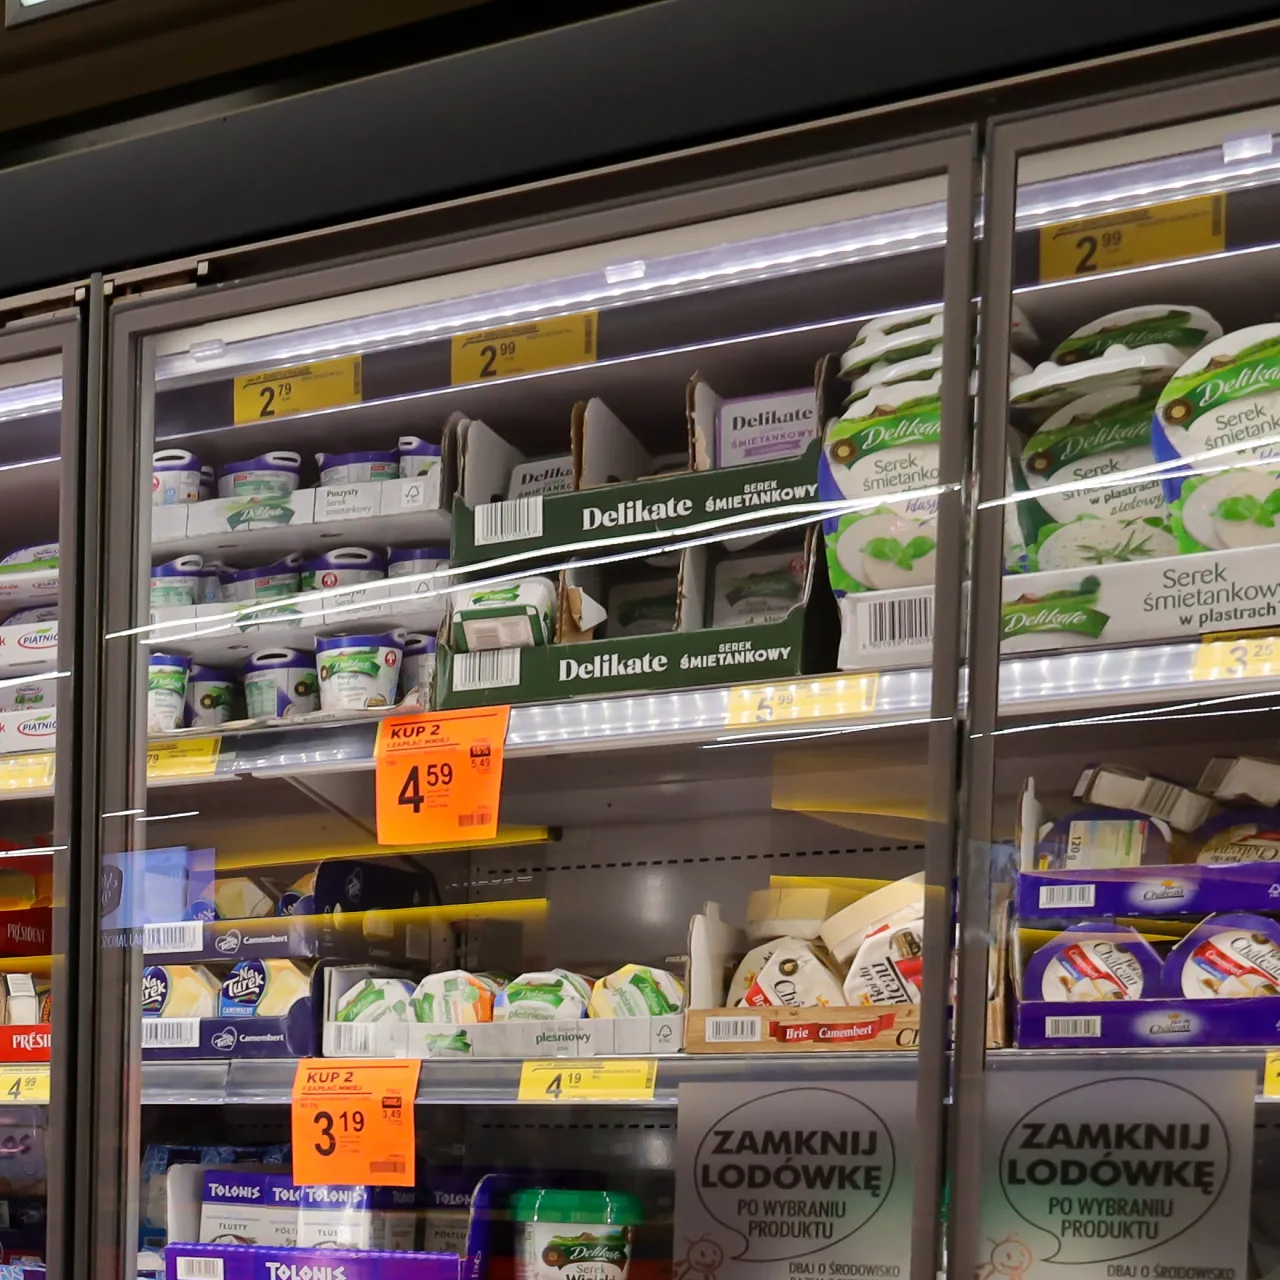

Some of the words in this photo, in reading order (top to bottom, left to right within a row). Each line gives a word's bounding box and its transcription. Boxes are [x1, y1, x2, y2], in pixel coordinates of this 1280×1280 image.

[1076, 236, 1097, 273] 2
[1102, 230, 1122, 246] 99
[480, 346, 497, 377] 2
[500, 342, 515, 355] 99
[260, 387, 275, 416] 2
[278, 384, 291, 396] 79
[875, 454, 917, 475] Serek
[1073, 460, 1120, 482] Serek
[705, 483, 818, 512] ŚMIETANKOWY
[744, 481, 777, 492] SEREK
[582, 498, 692, 531] Delikate
[1162, 563, 1227, 588] Serek
[1179, 613, 1192, 626] w
[1199, 604, 1276, 627] plastrach
[680, 646, 791, 668] ŚMIETANKOWY
[719, 642, 751, 652] SEREK
[559, 652, 667, 681] Delikate
[391, 726, 426, 739] KUP
[430, 724, 440, 736] 2
[398, 766, 424, 813] 4
[427, 763, 452, 786] 59
[243, 934, 288, 945] Camembert
[223, 970, 264, 995] Turek
[240, 1033, 284, 1042] Camembert
[785, 1025, 808, 1039] Brie
[818, 1023, 872, 1039] Camembert
[307, 1072, 338, 1083] KUP
[342, 1072, 353, 1082] 2
[546, 1073, 562, 1099] 4
[568, 1073, 581, 1084] 19
[313, 1111, 335, 1156] 3
[339, 1112, 364, 1133] 19
[711, 1129, 877, 1155] ZAMKNIJ
[1018, 1122, 1210, 1150] ZAMKNIJ
[701, 1157, 882, 1197] LODÓWKĘ
[1007, 1153, 1214, 1195] LODÓWKĘ
[738, 1200, 759, 1215] PO
[762, 1200, 846, 1218] WYBRANIU
[1049, 1198, 1072, 1215] PO
[1078, 1199, 1172, 1217] WYBRANIU
[748, 1220, 832, 1239] PRODUKTU
[1061, 1220, 1158, 1239] PRODUKTU
